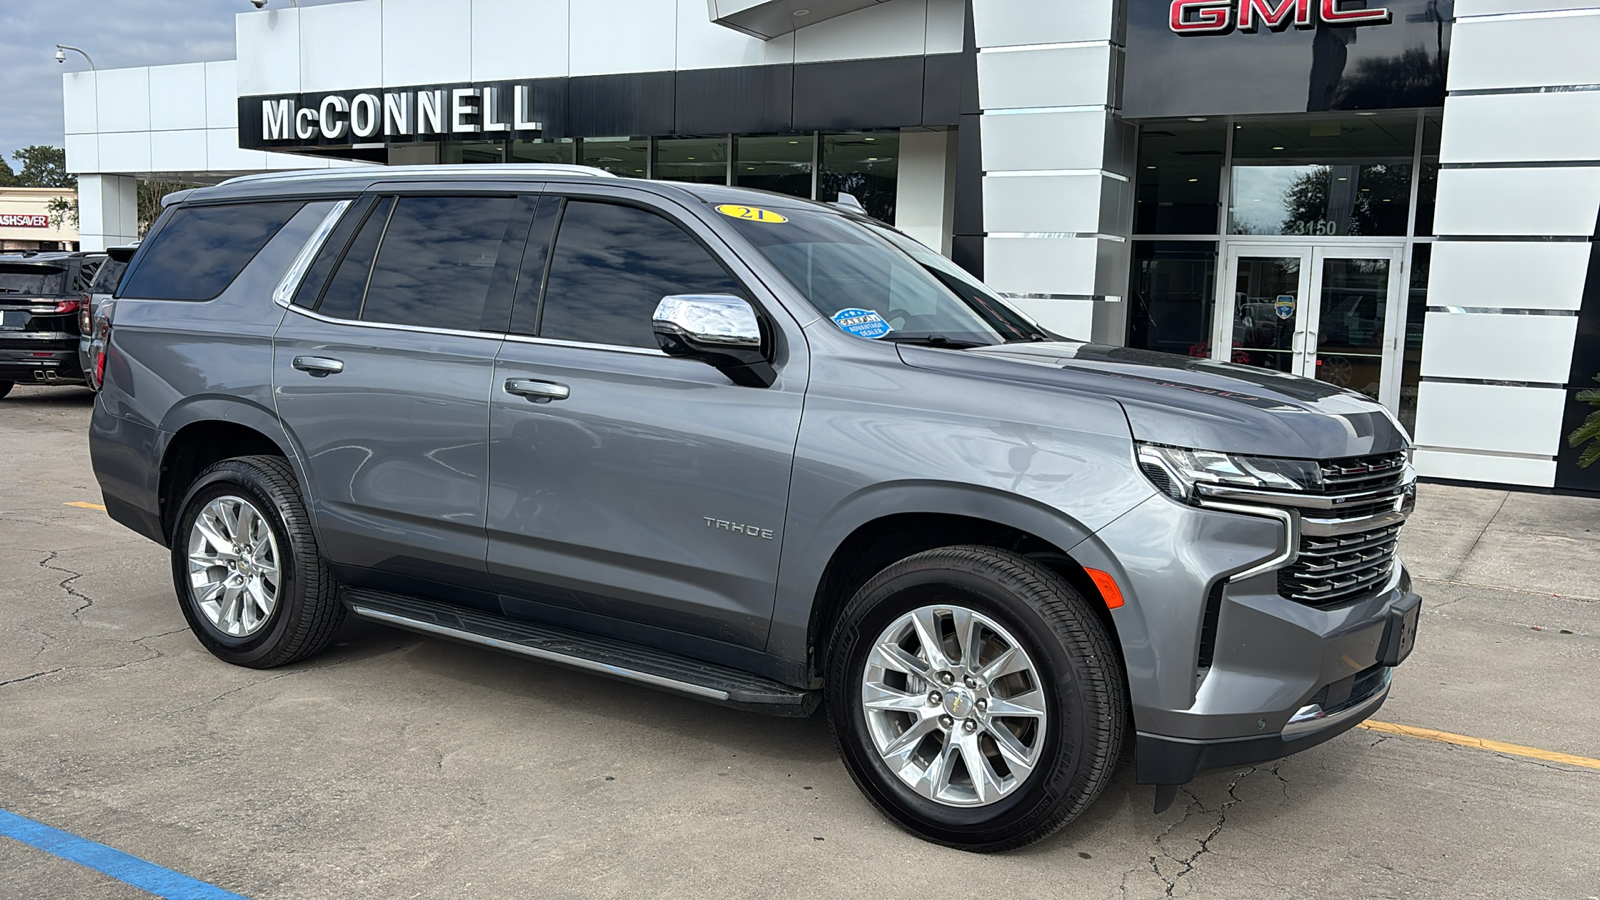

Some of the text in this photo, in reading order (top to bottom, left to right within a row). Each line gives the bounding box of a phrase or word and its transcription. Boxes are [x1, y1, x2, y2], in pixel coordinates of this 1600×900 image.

[1169, 0, 1390, 33] GMC
[262, 85, 542, 140] McCONNELL
[738, 207, 766, 220] 21
[1296, 220, 1337, 235] 3150
[860, 328, 884, 337] DEALER
[703, 516, 774, 539] TAHOE
